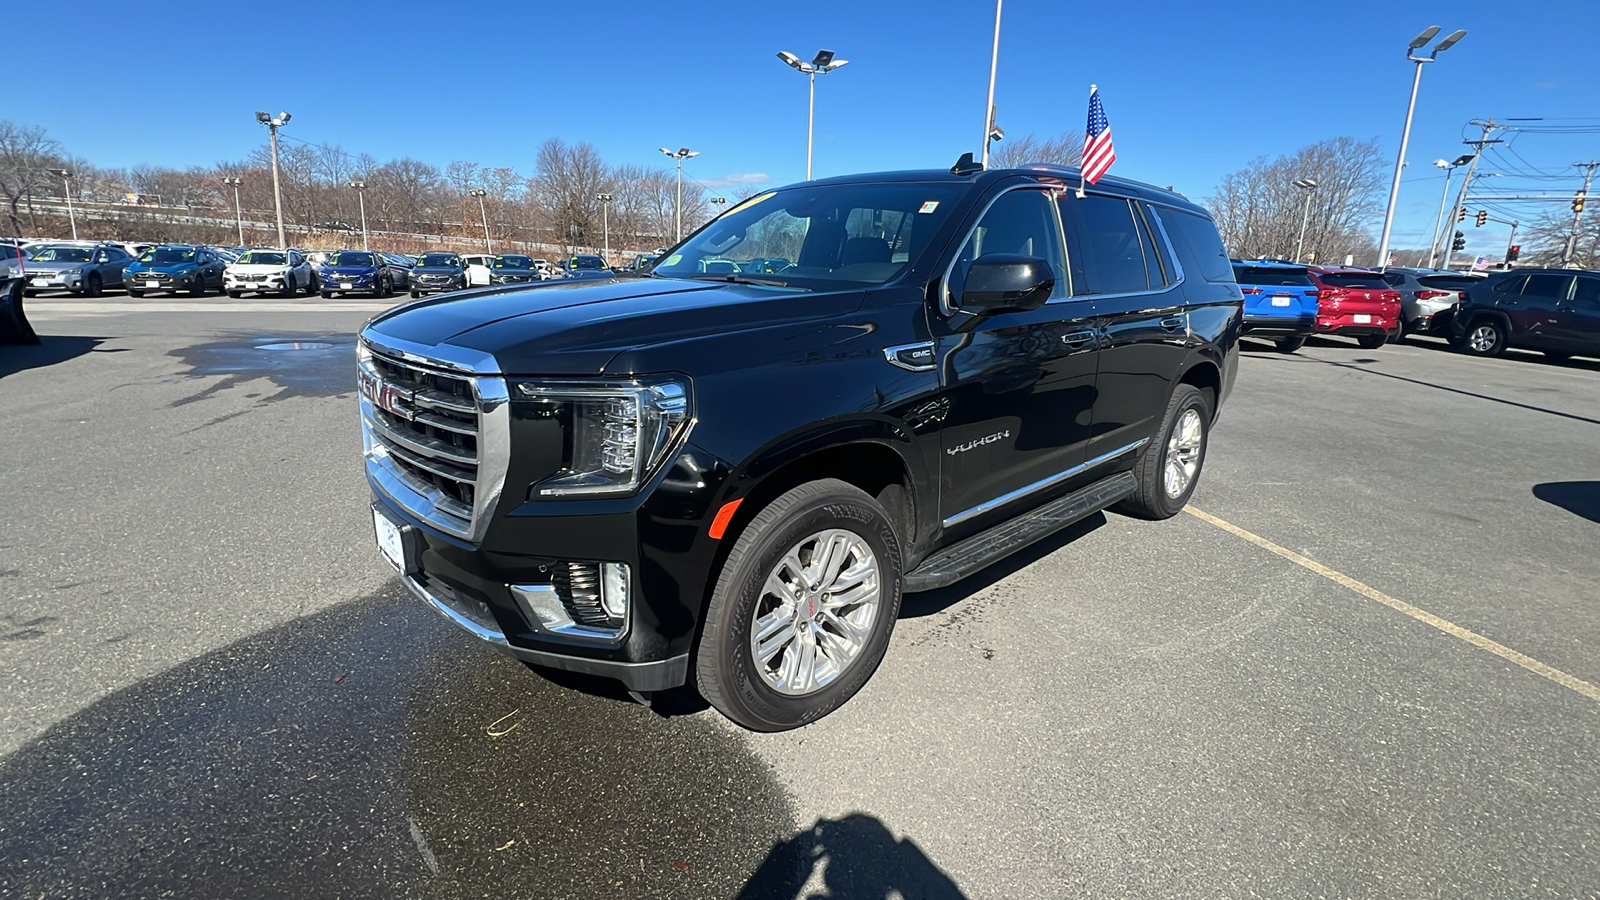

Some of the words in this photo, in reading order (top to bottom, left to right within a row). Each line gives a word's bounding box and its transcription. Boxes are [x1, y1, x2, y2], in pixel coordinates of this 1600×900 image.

[912, 349, 931, 358] GMC
[362, 373, 413, 421] GMC
[946, 429, 1010, 456] YUKON
